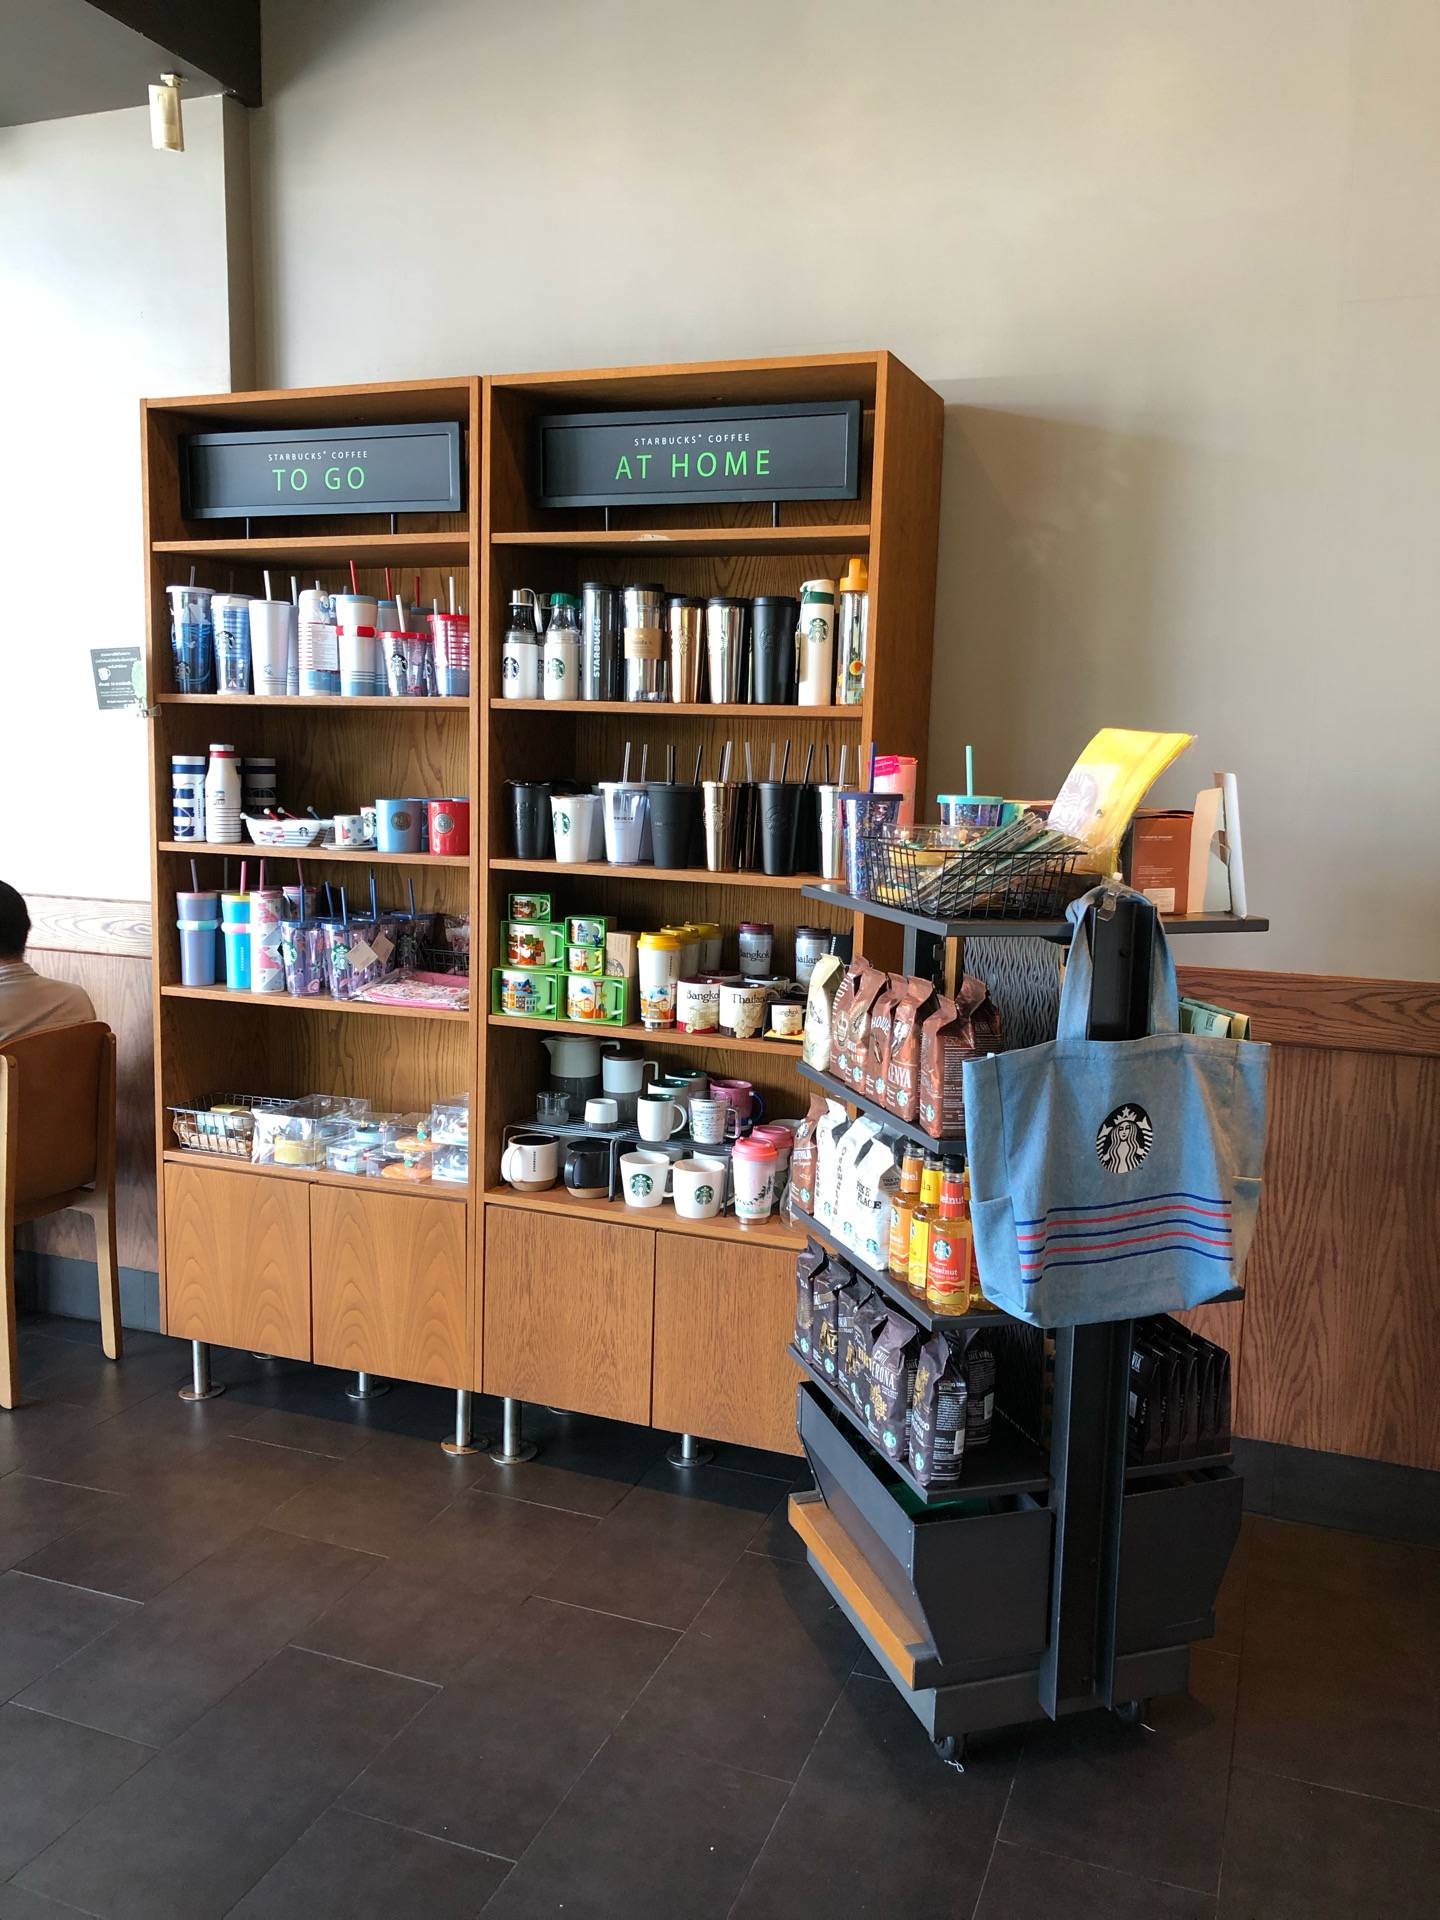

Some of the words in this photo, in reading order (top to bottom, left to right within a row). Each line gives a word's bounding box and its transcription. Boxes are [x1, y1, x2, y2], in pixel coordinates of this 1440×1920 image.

[634, 435, 697, 447] STARBUCKS
[708, 432, 751, 443] COFFEE
[268, 451, 323, 462] STARBUCKS
[331, 450, 368, 460] COFFEE
[615, 453, 653, 481] AT
[671, 449, 771, 479] HOME
[272, 468, 308, 491] TO
[324, 466, 365, 490] GO
[686, 989, 720, 1003] Bangko
